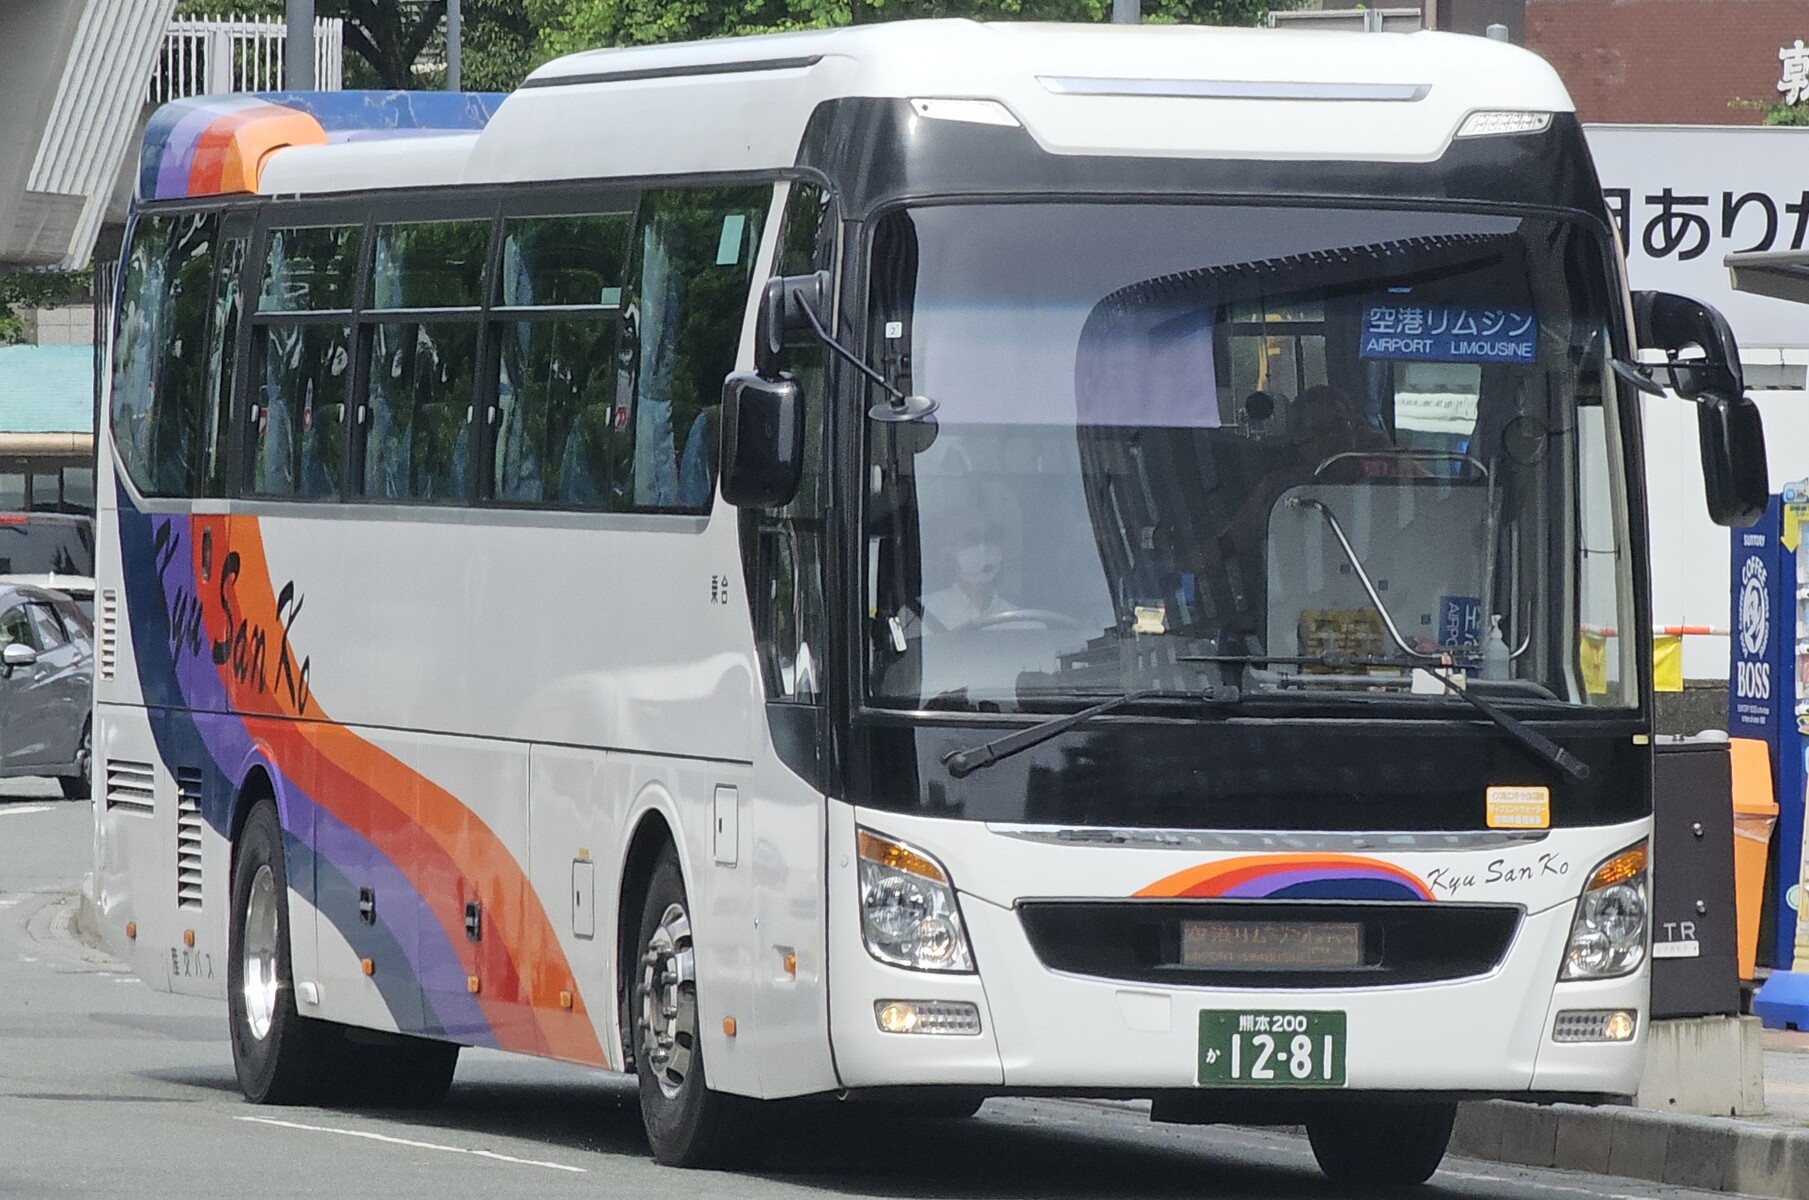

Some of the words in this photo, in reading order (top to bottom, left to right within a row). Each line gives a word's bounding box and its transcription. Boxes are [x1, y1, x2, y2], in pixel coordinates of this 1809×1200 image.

[1369, 306, 1532, 337] 空港リムジン
[1367, 338, 1433, 353] AIRPORT
[1451, 341, 1532, 357] LIMOUSINE
[1742, 555, 1767, 587] COFFEE
[212, 551, 265, 694] San
[273, 579, 310, 715] Ko
[1737, 661, 1770, 699] BOSS
[1427, 867, 1476, 895] Kyu
[1485, 859, 1533, 884] San
[1538, 853, 1569, 875] Ko
[1206, 1048, 1221, 1064] か
[1231, 1033, 1333, 1080] 12-81
